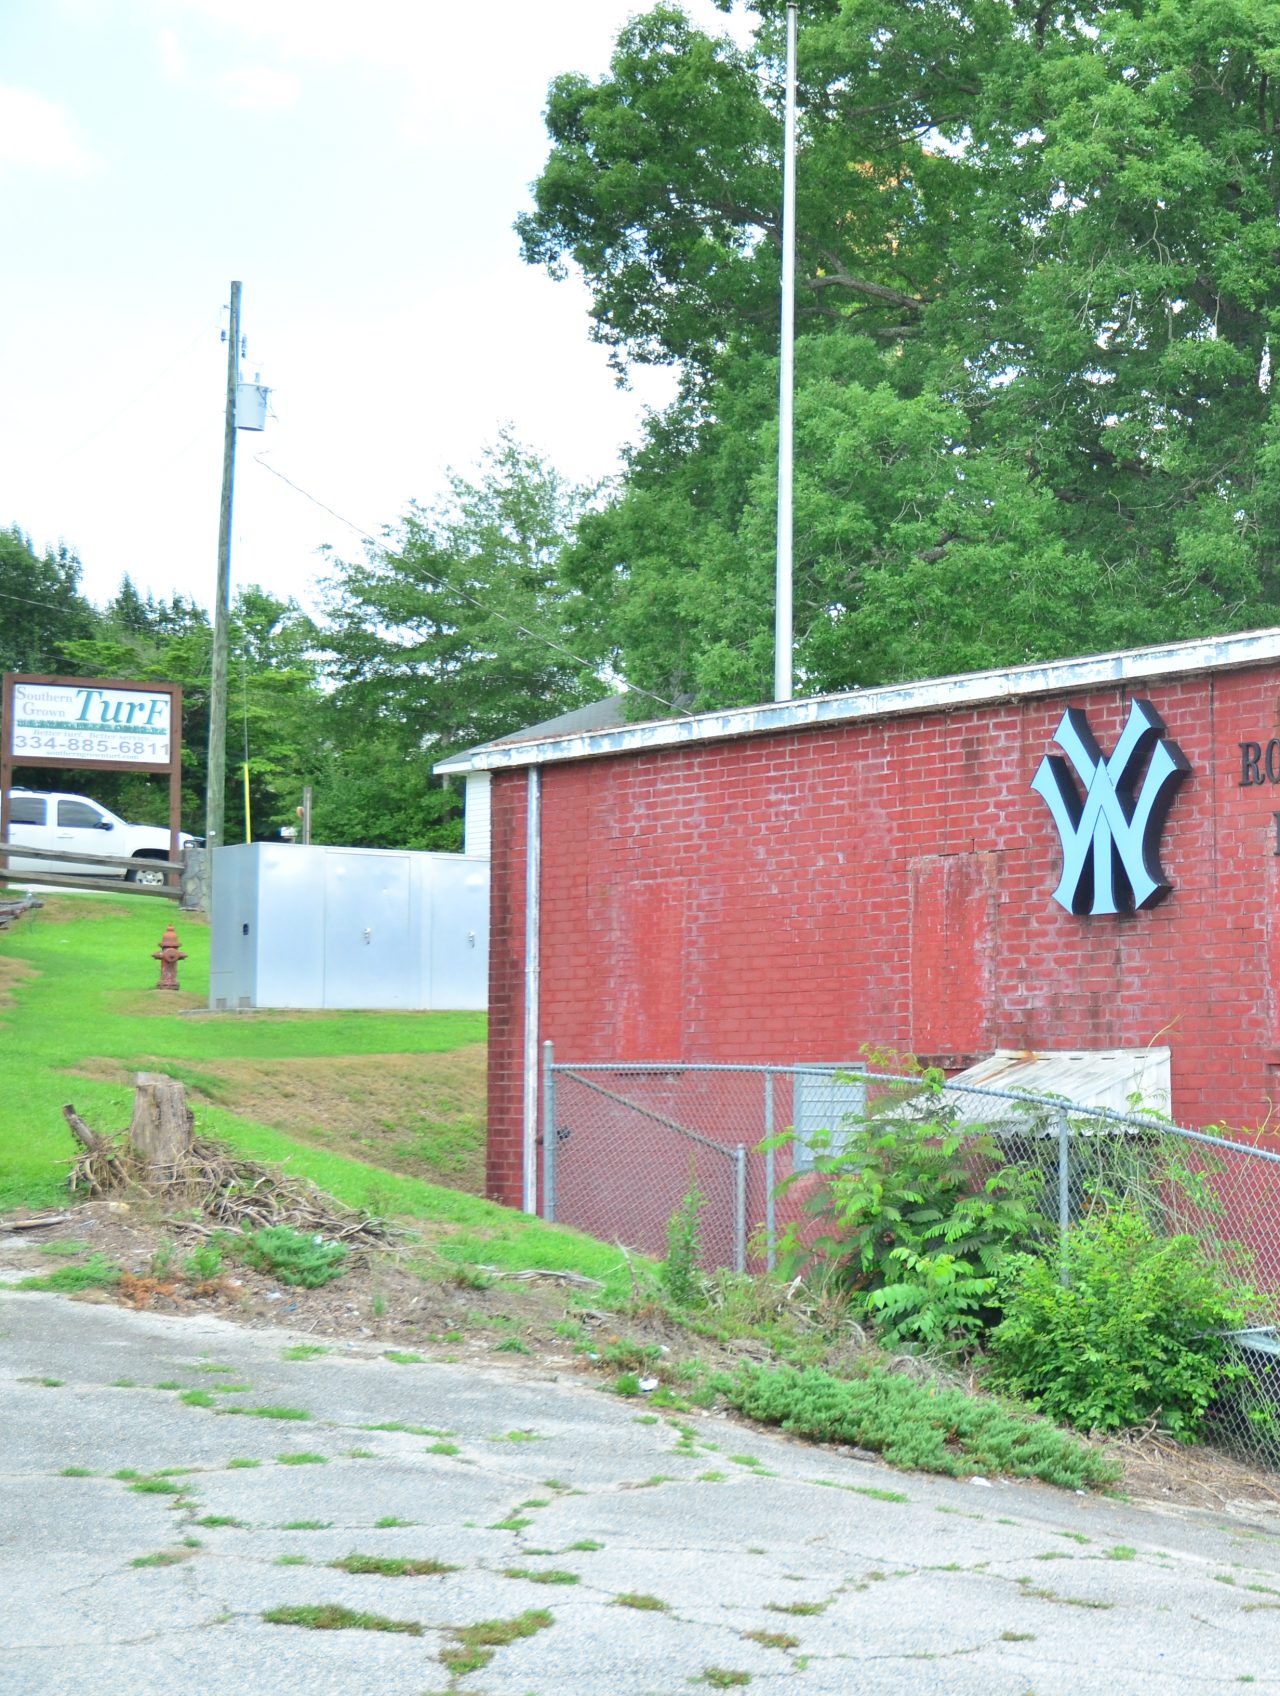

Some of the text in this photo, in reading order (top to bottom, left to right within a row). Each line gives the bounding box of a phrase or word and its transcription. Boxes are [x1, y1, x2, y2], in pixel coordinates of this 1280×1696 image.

[16, 686, 73, 702] Southern
[23, 701, 66, 717] Grown
[15, 735, 170, 756] 334-885-6811
